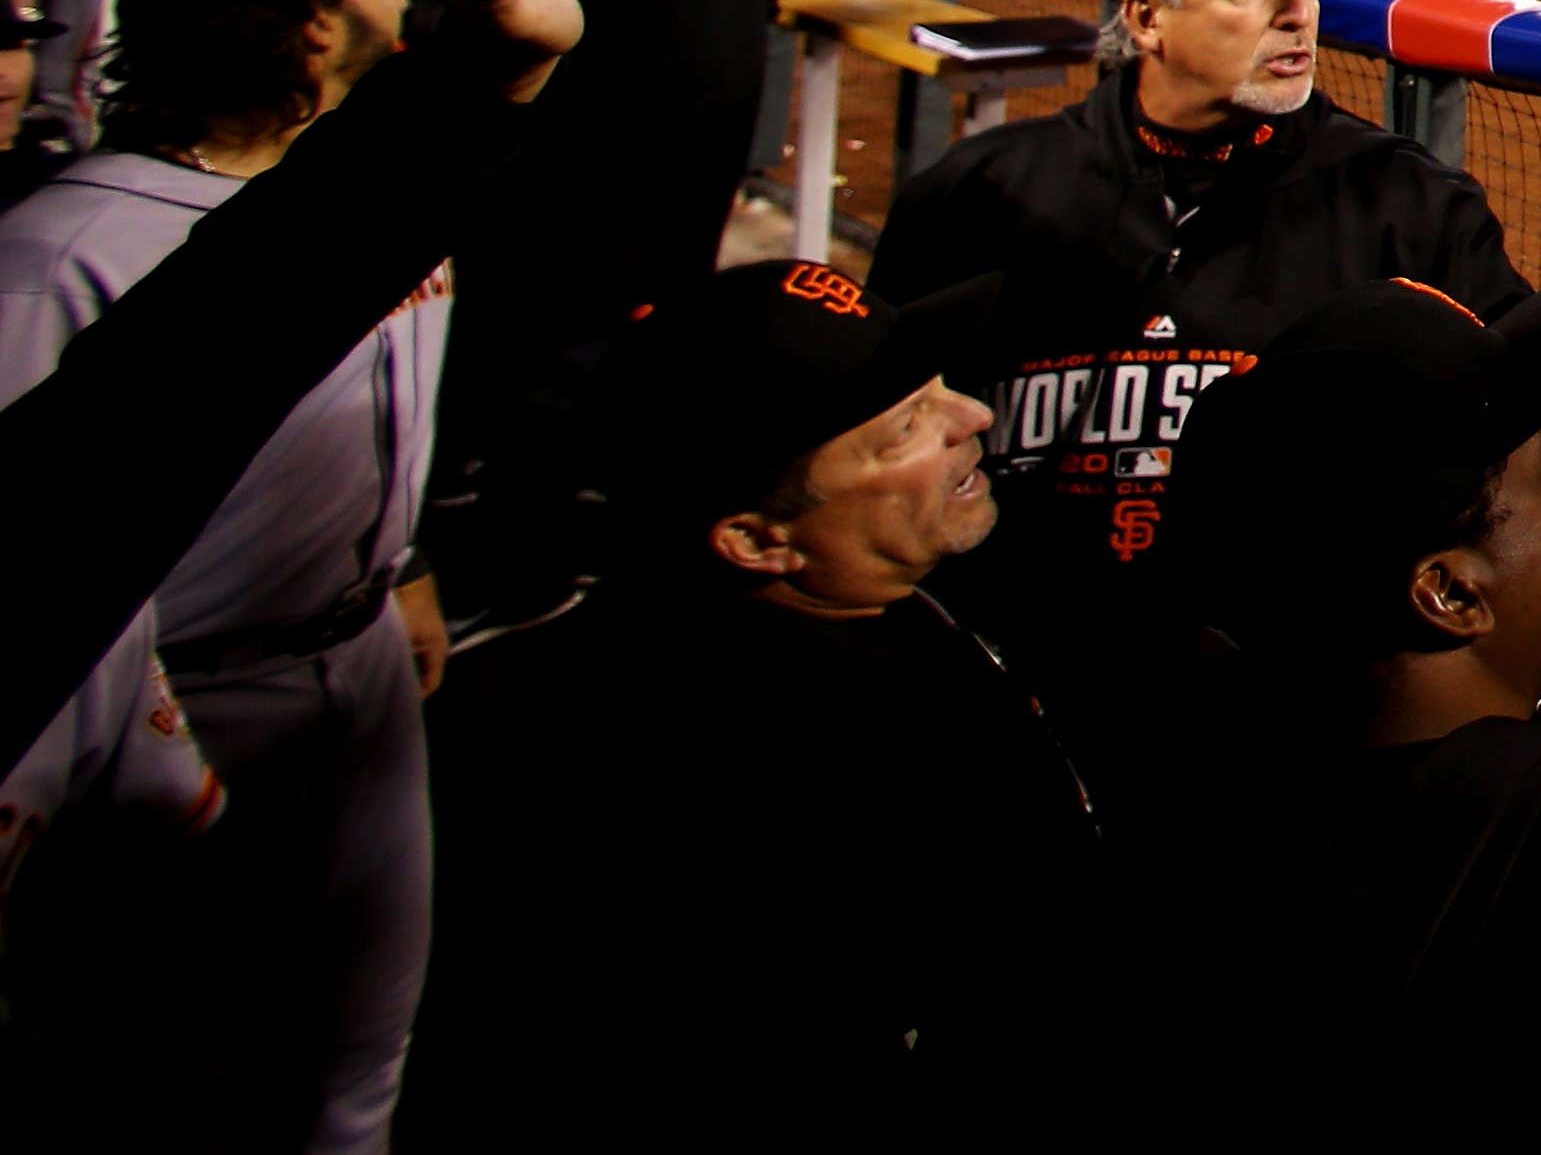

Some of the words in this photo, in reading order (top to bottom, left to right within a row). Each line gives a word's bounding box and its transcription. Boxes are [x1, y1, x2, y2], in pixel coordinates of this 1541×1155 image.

[1104, 350, 1180, 362] EAGUE
[986, 364, 1149, 456] WORLD
[1158, 364, 1232, 442] S
